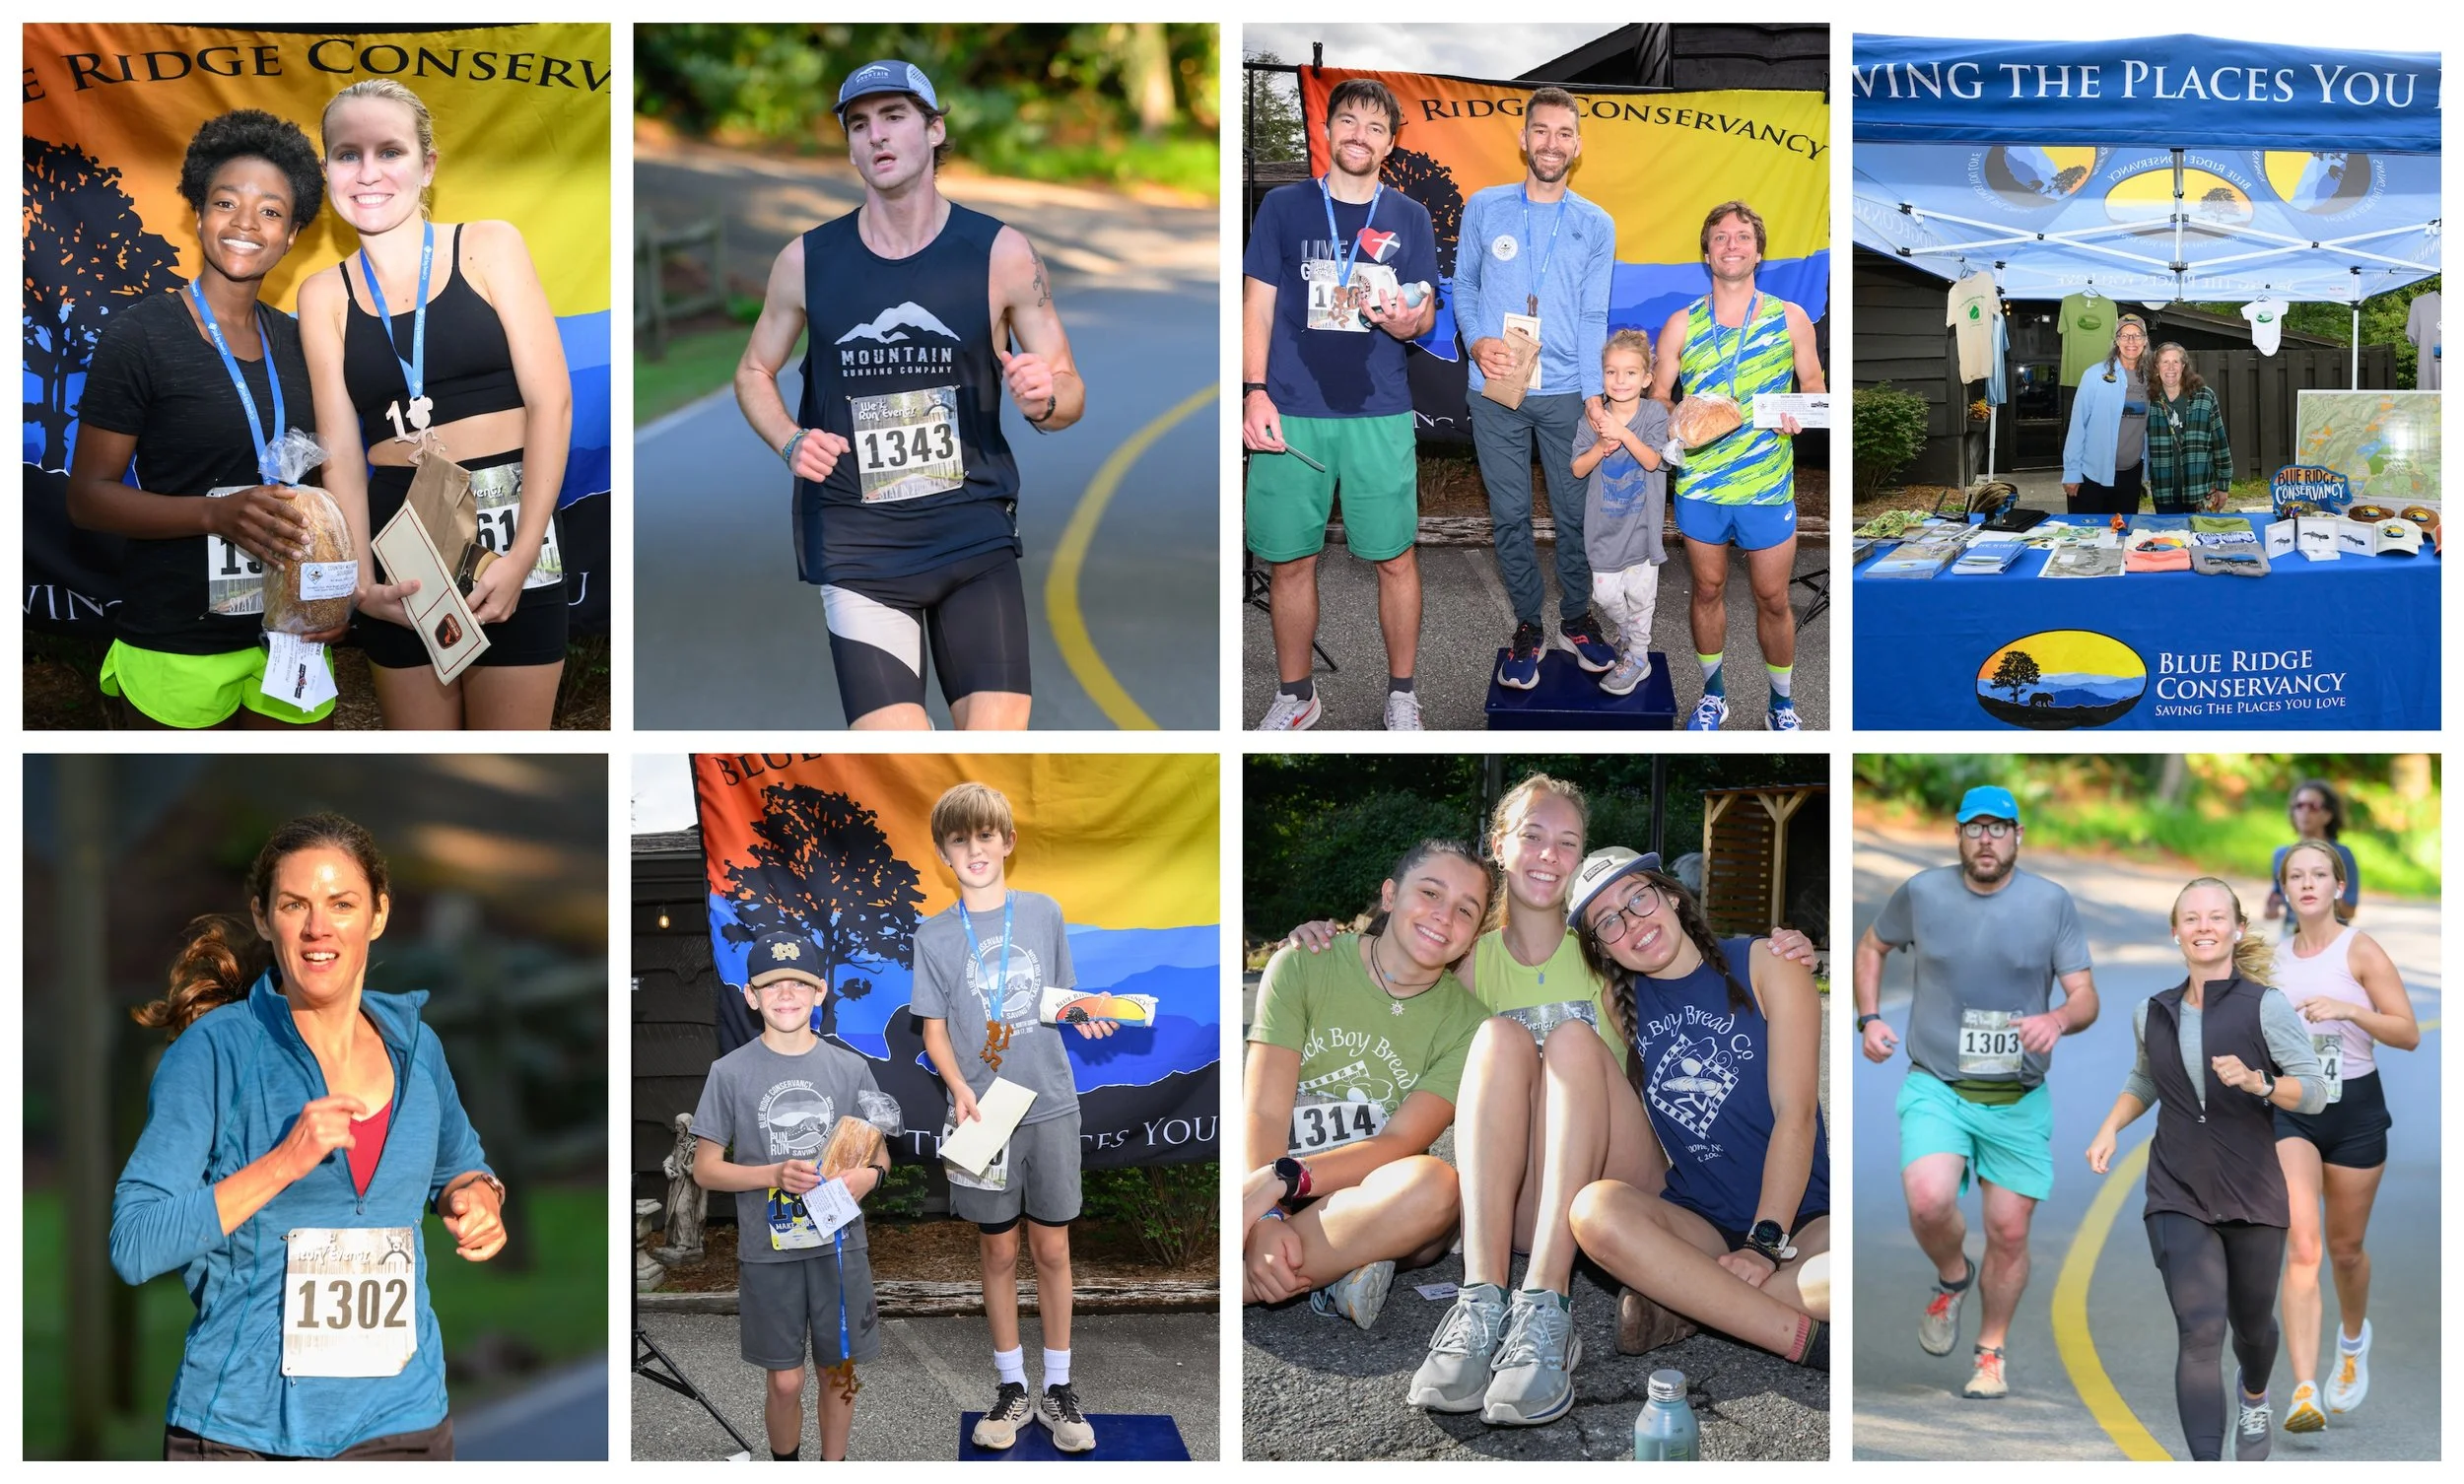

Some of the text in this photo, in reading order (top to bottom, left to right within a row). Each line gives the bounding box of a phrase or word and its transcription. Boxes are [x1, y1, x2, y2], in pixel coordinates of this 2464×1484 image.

[61, 45, 282, 91] RIDGE
[1999, 63, 2101, 99] THE
[2121, 59, 2294, 102] PLACES
[2309, 64, 2418, 108] YOU
[1418, 99, 1526, 122] RIDG
[841, 347, 952, 366] MOUNTAIN
[843, 366, 952, 377] RUNNING COMPANY
[864, 423, 954, 469] 1343
[2277, 468, 2337, 486] BLUE RIDGE
[2275, 483, 2344, 505] CONSERVANCY
[23, 584, 122, 620] VIN
[2158, 649, 2312, 674] BLUE RIDGE
[2156, 672, 2347, 700] CONSERVANCY
[2155, 697, 2347, 716] SAVING THE PLACES YOU LOVE
[1647, 1013, 1682, 1038] Boy
[1684, 1005, 1735, 1035] Bread
[1965, 1032, 2019, 1054] 1303
[1301, 1027, 1419, 1090] ick Boy Bread
[758, 1079, 814, 1129] BLUE RIDGE CONSERVANCY
[1143, 1115, 1218, 1146] YOU
[771, 1143, 789, 1156] RUN
[297, 1279, 408, 1329] 1302
